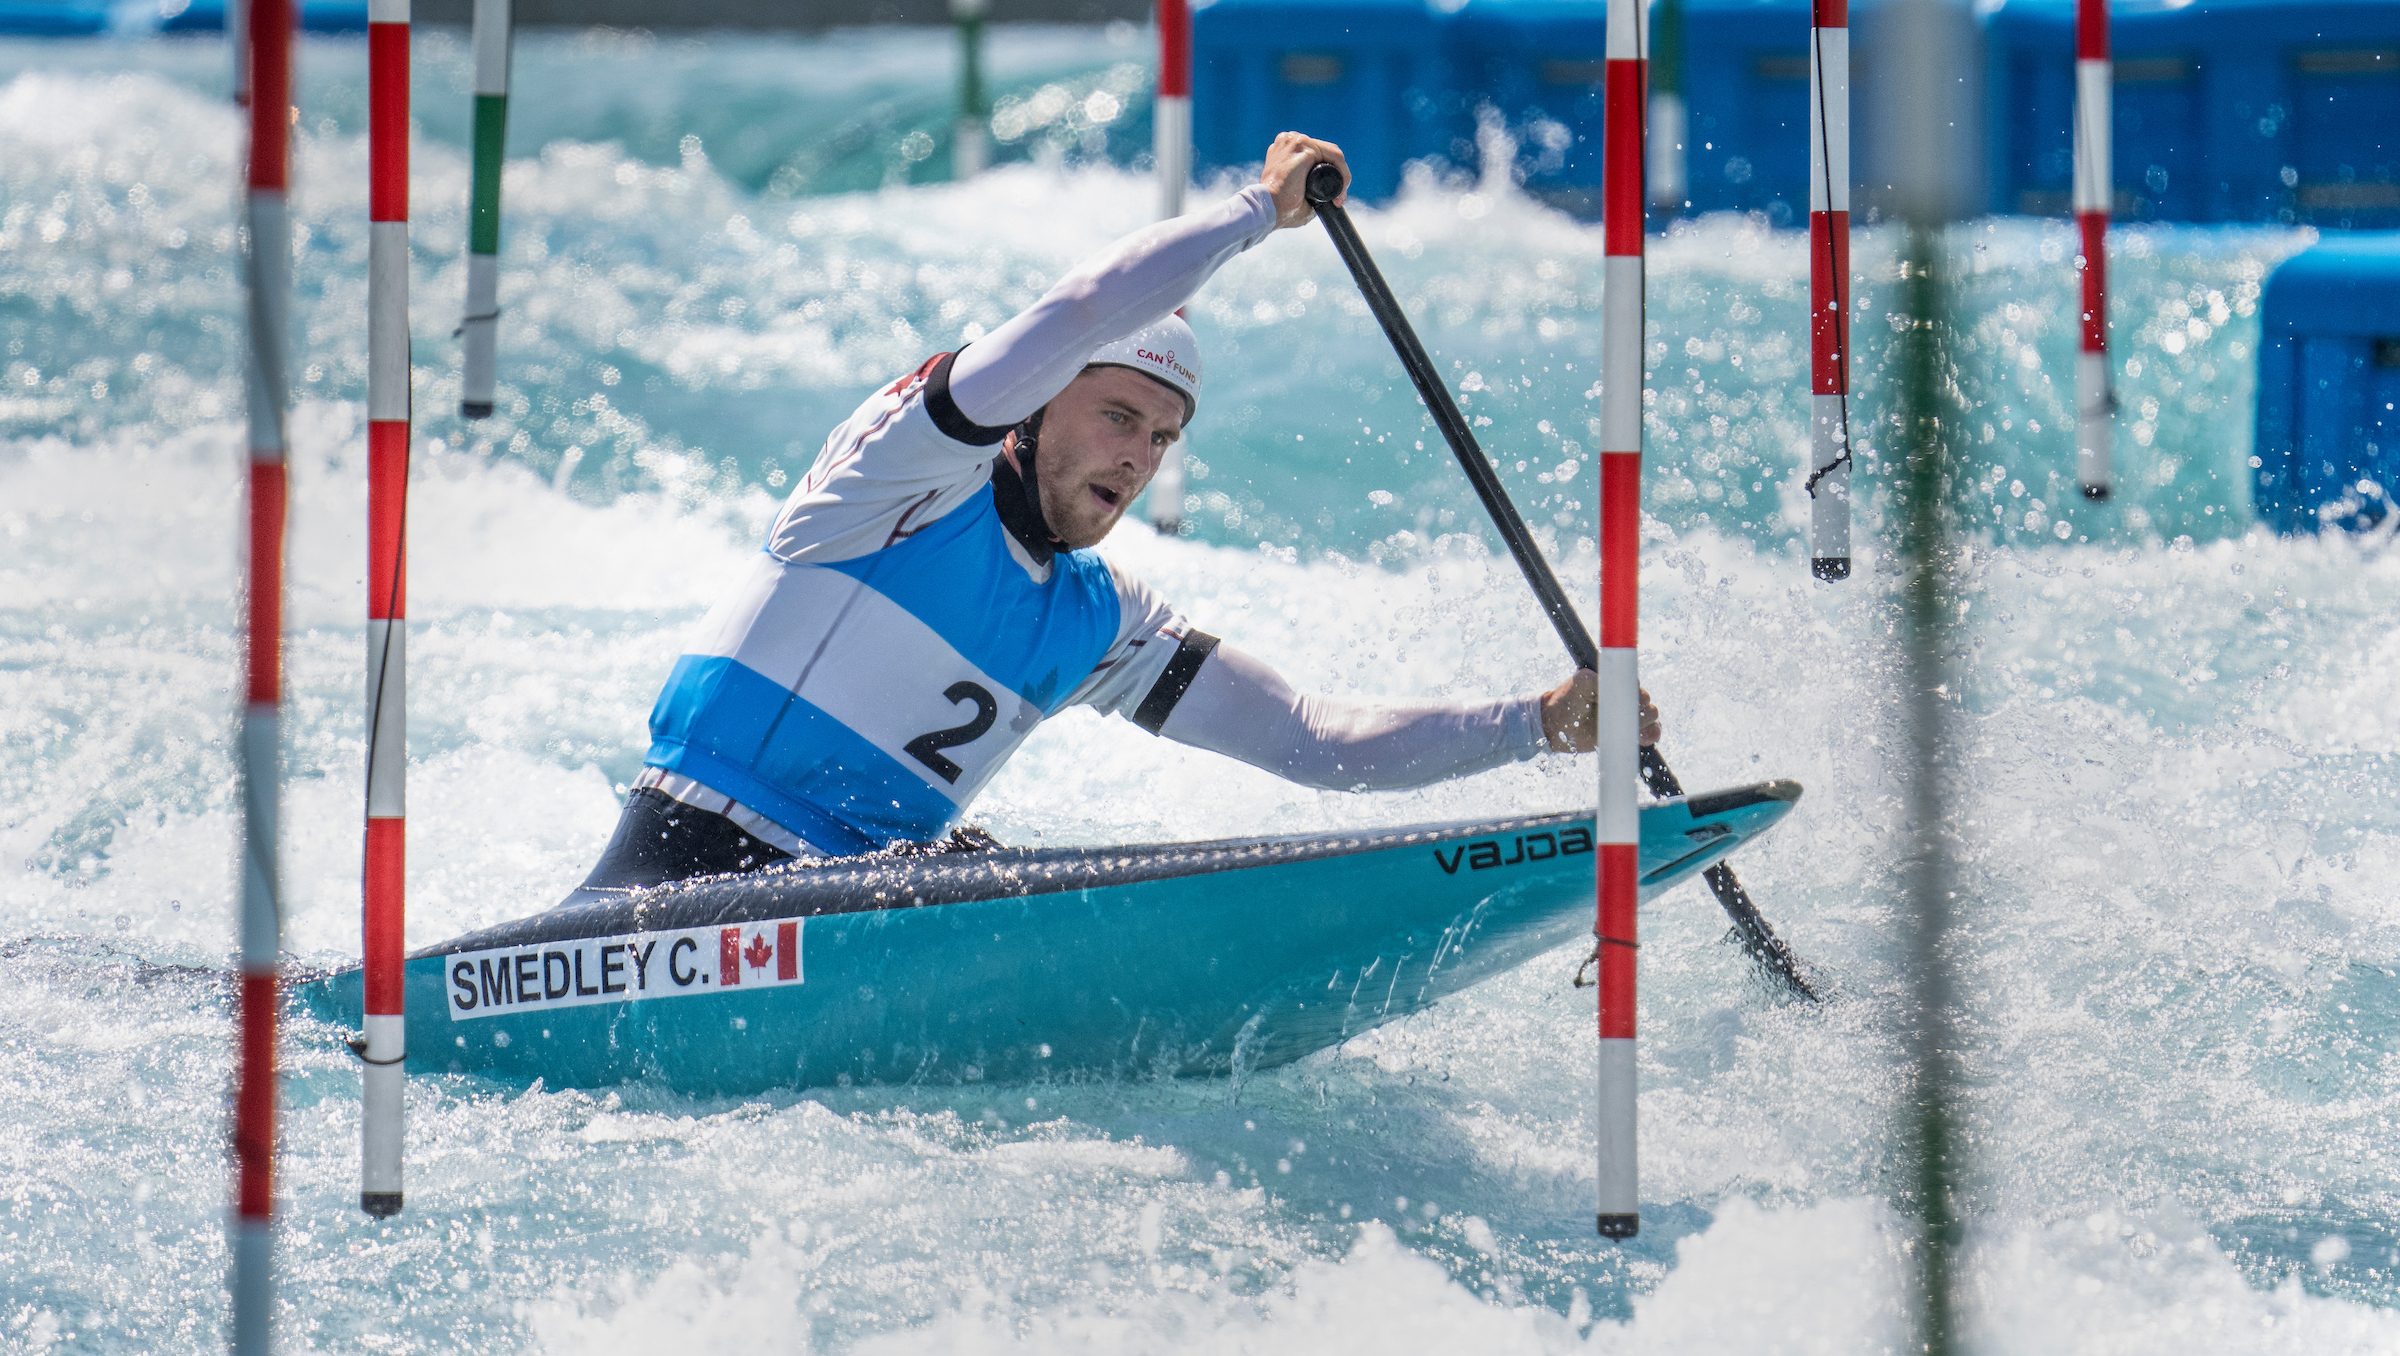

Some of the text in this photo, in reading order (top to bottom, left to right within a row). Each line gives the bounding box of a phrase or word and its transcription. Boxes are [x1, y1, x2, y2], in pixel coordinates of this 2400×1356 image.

[1137, 348, 1164, 364] CAN
[1172, 362, 1196, 384] FUND
[903, 680, 998, 785] 2
[452, 937, 709, 1010] SMEDLEY C.
